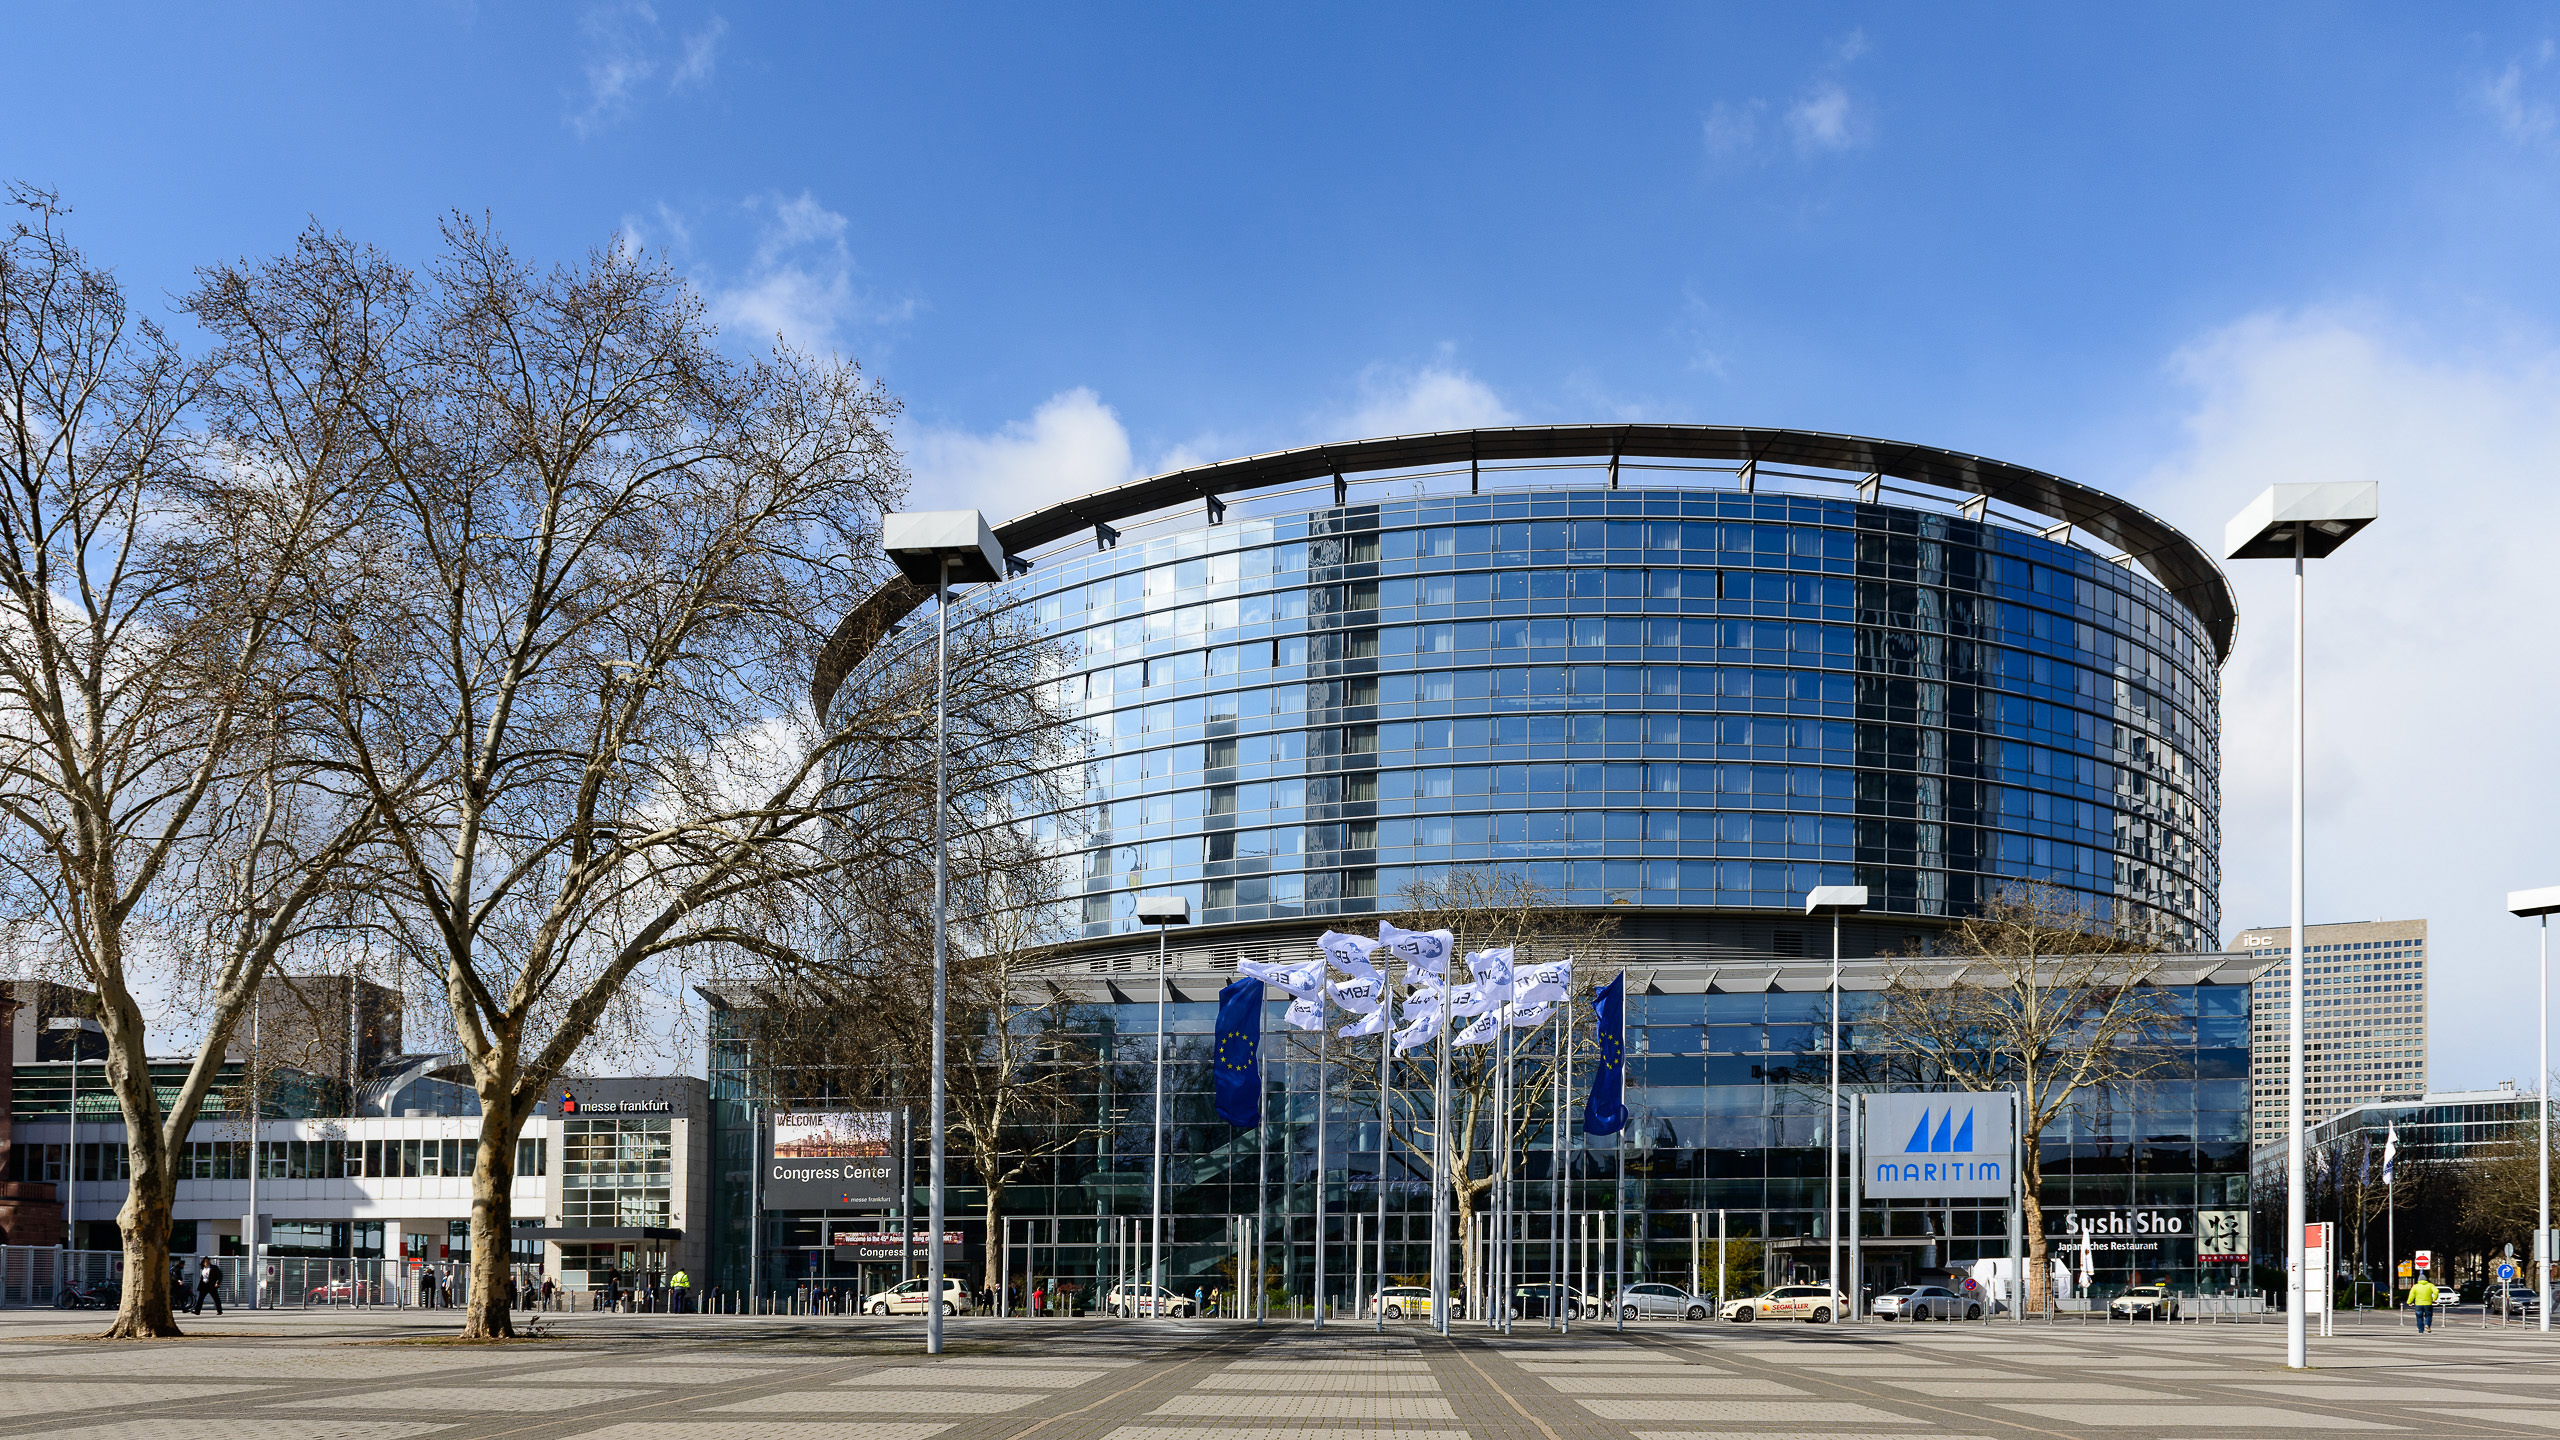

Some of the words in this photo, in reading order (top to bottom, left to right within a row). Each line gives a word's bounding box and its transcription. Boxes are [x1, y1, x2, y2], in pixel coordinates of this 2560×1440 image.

[2244, 934, 2273, 947] ibc
[580, 1103, 617, 1112] messe
[620, 1100, 669, 1112] frankfurt
[777, 1114, 823, 1126] WELCOME
[773, 1166, 840, 1183] Congress
[843, 1165, 891, 1179] Center
[1877, 1162, 2000, 1182] MARITIM
[859, 1247, 904, 1258] Congress
[2057, 1241, 2109, 1253] Japanches
[2110, 1241, 2158, 1251] Restaurant
